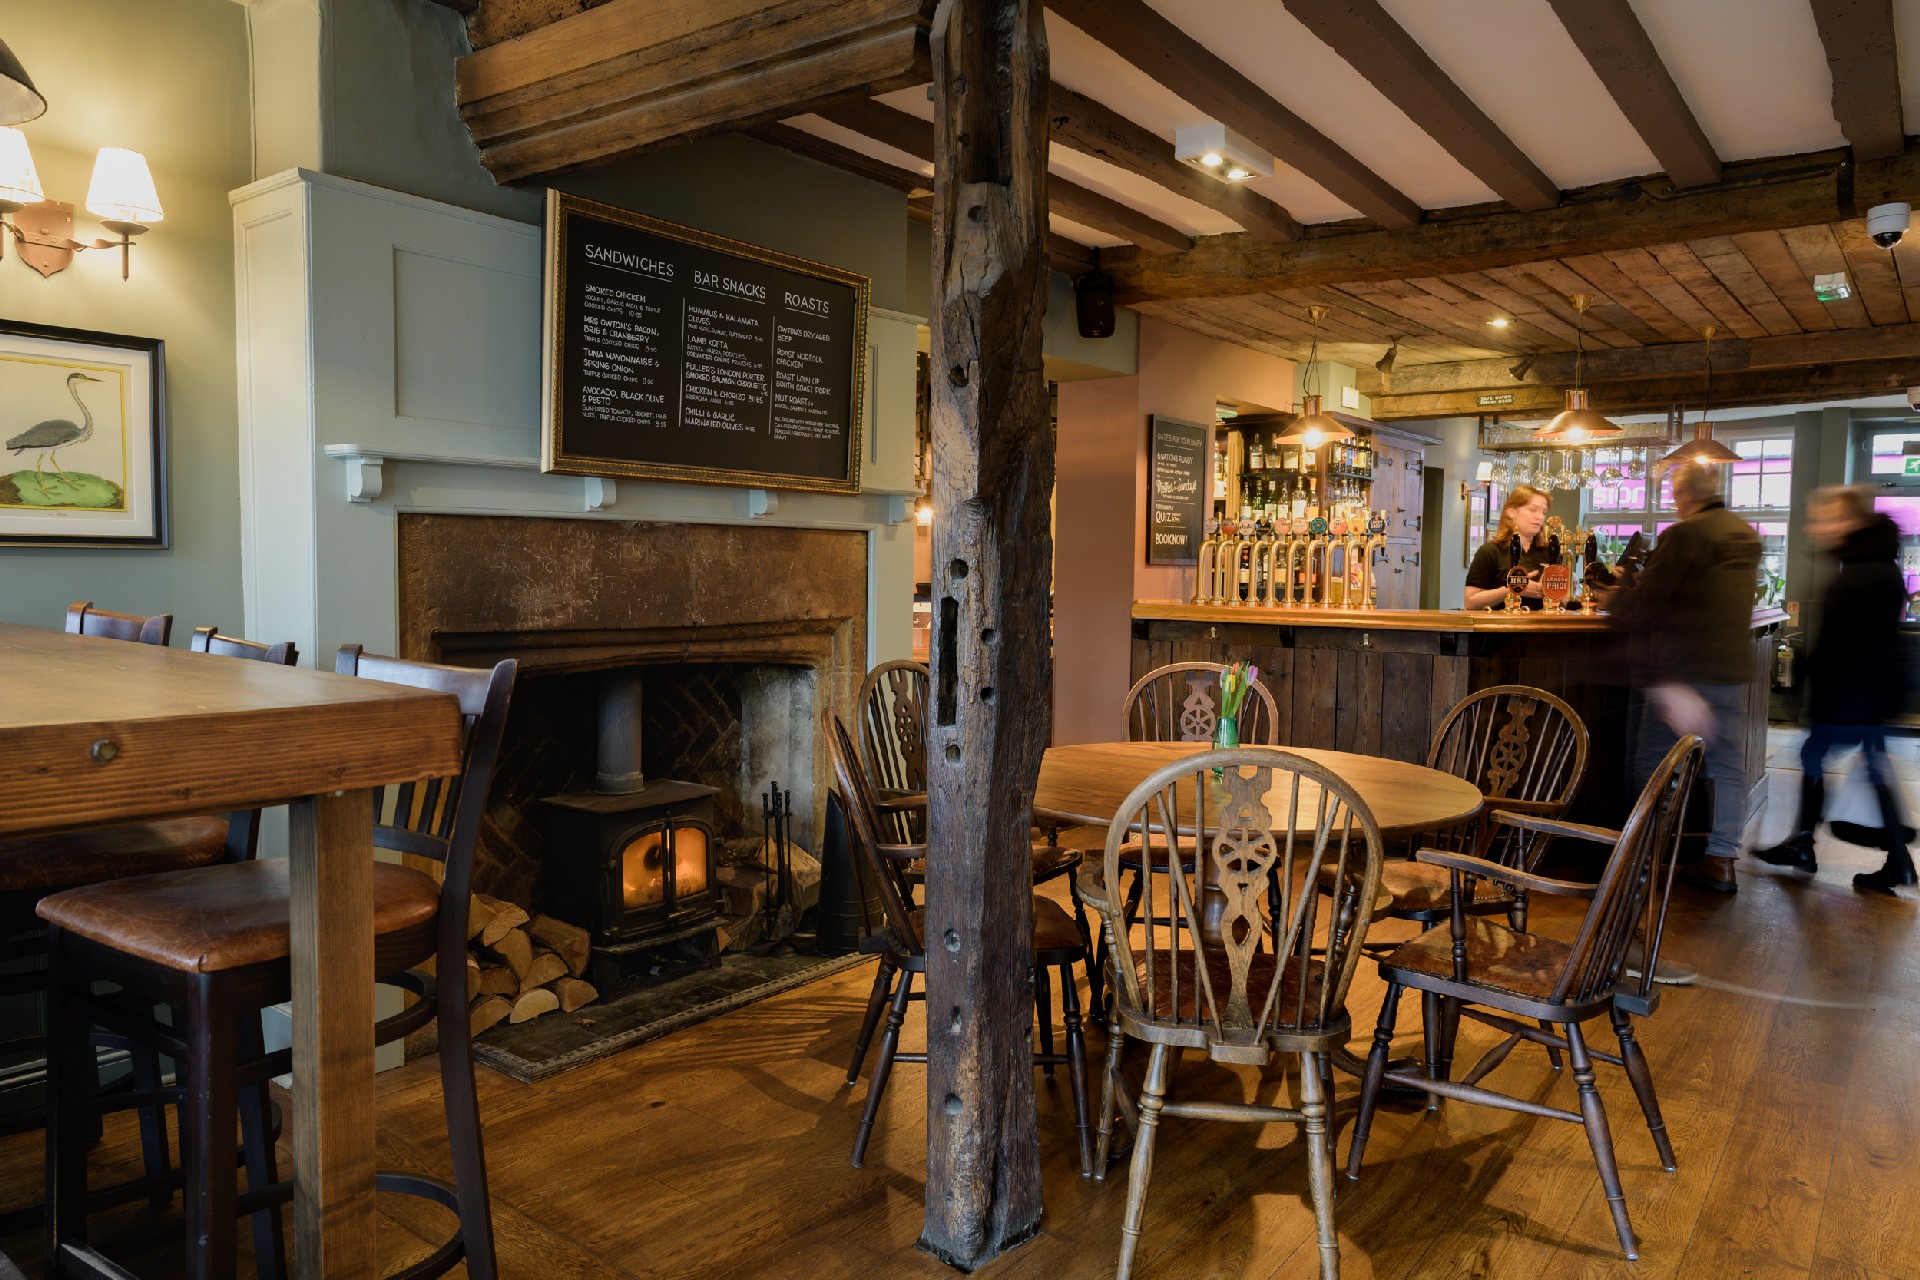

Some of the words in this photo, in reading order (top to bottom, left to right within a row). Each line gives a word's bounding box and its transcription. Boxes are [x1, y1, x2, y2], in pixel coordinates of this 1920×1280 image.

[585, 244, 674, 277] SANDWICHES
[694, 270, 719, 288] BAR
[722, 278, 766, 299] SNACKS
[585, 284, 614, 296] SMOKED
[616, 290, 646, 302] CHICKEN
[785, 291, 829, 313] ROASTS
[688, 305, 718, 318] HUMMUS
[725, 314, 760, 326] KALAMATA
[584, 324, 600, 335] BRIE
[610, 330, 650, 343] CRANBERRY
[778, 334, 793, 342] BEEF
[815, 334, 830, 342] AGED
[687, 334, 706, 345] LAMB
[709, 339, 728, 350] KOFTA
[583, 348, 604, 358] TUNA
[606, 352, 653, 366] MAYONNAISE
[777, 348, 796, 358] ROAST
[583, 358, 610, 370] SPRING
[612, 363, 634, 373] ONION
[776, 358, 804, 369] CHICKEN
[686, 362, 716, 374] FULLER'S
[717, 368, 741, 378] LONDON
[742, 372, 765, 381] PORTER
[686, 371, 710, 382] SMOKED
[712, 375, 735, 385] SALMON
[776, 370, 795, 381] ROAST
[796, 374, 811, 384] LOIN
[582, 386, 618, 399] AVOCADO,
[620, 390, 644, 401] BLACK
[645, 394, 665, 404] OLIVE
[686, 384, 713, 396] CHICKEN
[720, 391, 746, 401] CHORIZO
[748, 394, 764, 404] BITES
[776, 380, 794, 390] SOUTH
[796, 384, 813, 393] COAST
[815, 386, 831, 395] PORK
[588, 395, 611, 405] PESTO
[775, 394, 788, 402] NUT
[789, 396, 808, 406] ROAST
[686, 407, 705, 417] CHILLI
[712, 411, 736, 421] GARLIC
[685, 416, 721, 428] MARINATED
[722, 421, 744, 431] OLIVES
[1161, 454, 1178, 462] NATIONS
[1179, 456, 1193, 464] RUGBY
[1156, 510, 1171, 523] QUIZ
[1156, 533, 1172, 545] BOOK
[1546, 582, 1567, 590] PRIDE
